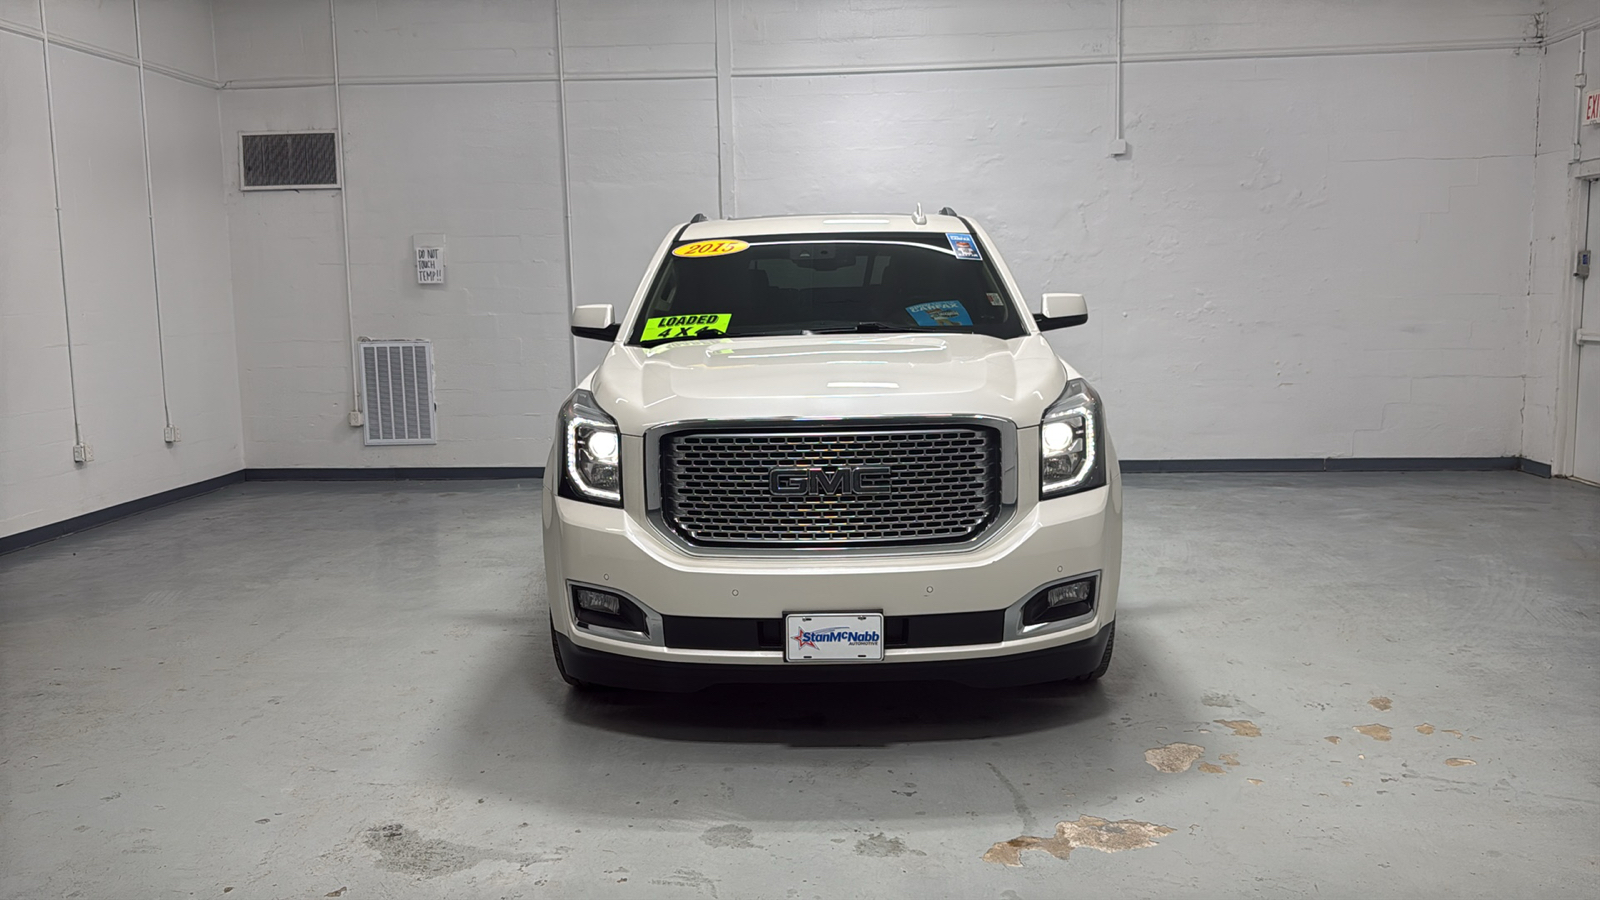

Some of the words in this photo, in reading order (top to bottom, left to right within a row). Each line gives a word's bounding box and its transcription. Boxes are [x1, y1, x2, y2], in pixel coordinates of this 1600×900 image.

[1587, 94, 1600, 120] EXI
[418, 249, 426, 259] DO
[427, 249, 439, 259] NOT
[684, 243, 737, 254] 2015
[418, 260, 435, 270] TOUCH
[419, 269, 442, 281] TEMP!!
[658, 315, 719, 328] LOADED
[769, 467, 892, 495] GMC
